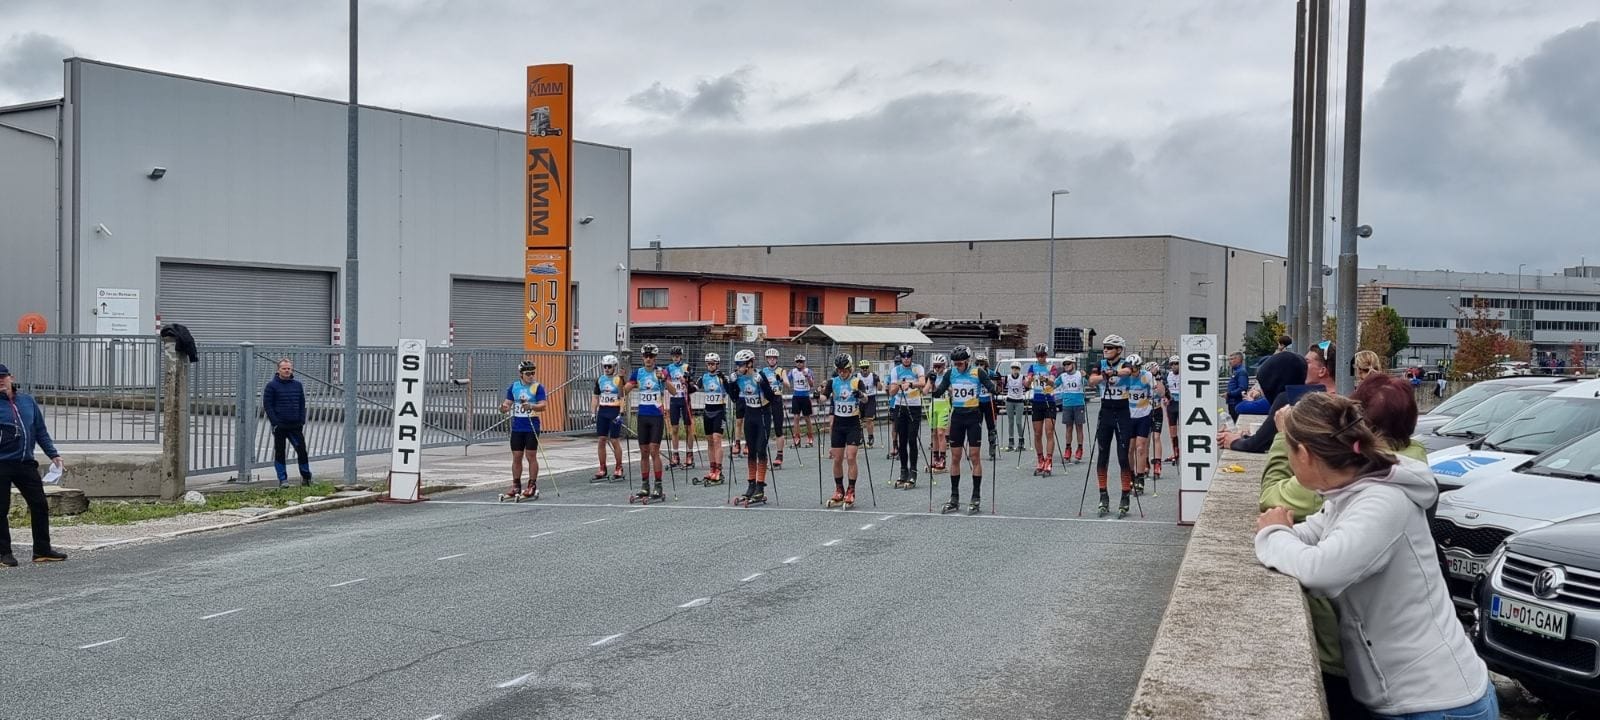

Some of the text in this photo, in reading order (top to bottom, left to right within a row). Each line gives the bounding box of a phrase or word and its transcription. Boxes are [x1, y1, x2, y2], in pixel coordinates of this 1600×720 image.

[529, 77, 563, 96] KIMM
[528, 147, 561, 236] KIMM
[545, 280, 558, 347] PRO
[641, 393, 657, 402] 201
[706, 394, 720, 402] 207
[954, 388, 975, 398] 204
[398, 354, 420, 465] START
[837, 405, 853, 413] 203
[1186, 353, 1212, 481] START
[1499, 601, 1513, 619] LJ
[1519, 606, 1563, 635] 01-GAM
